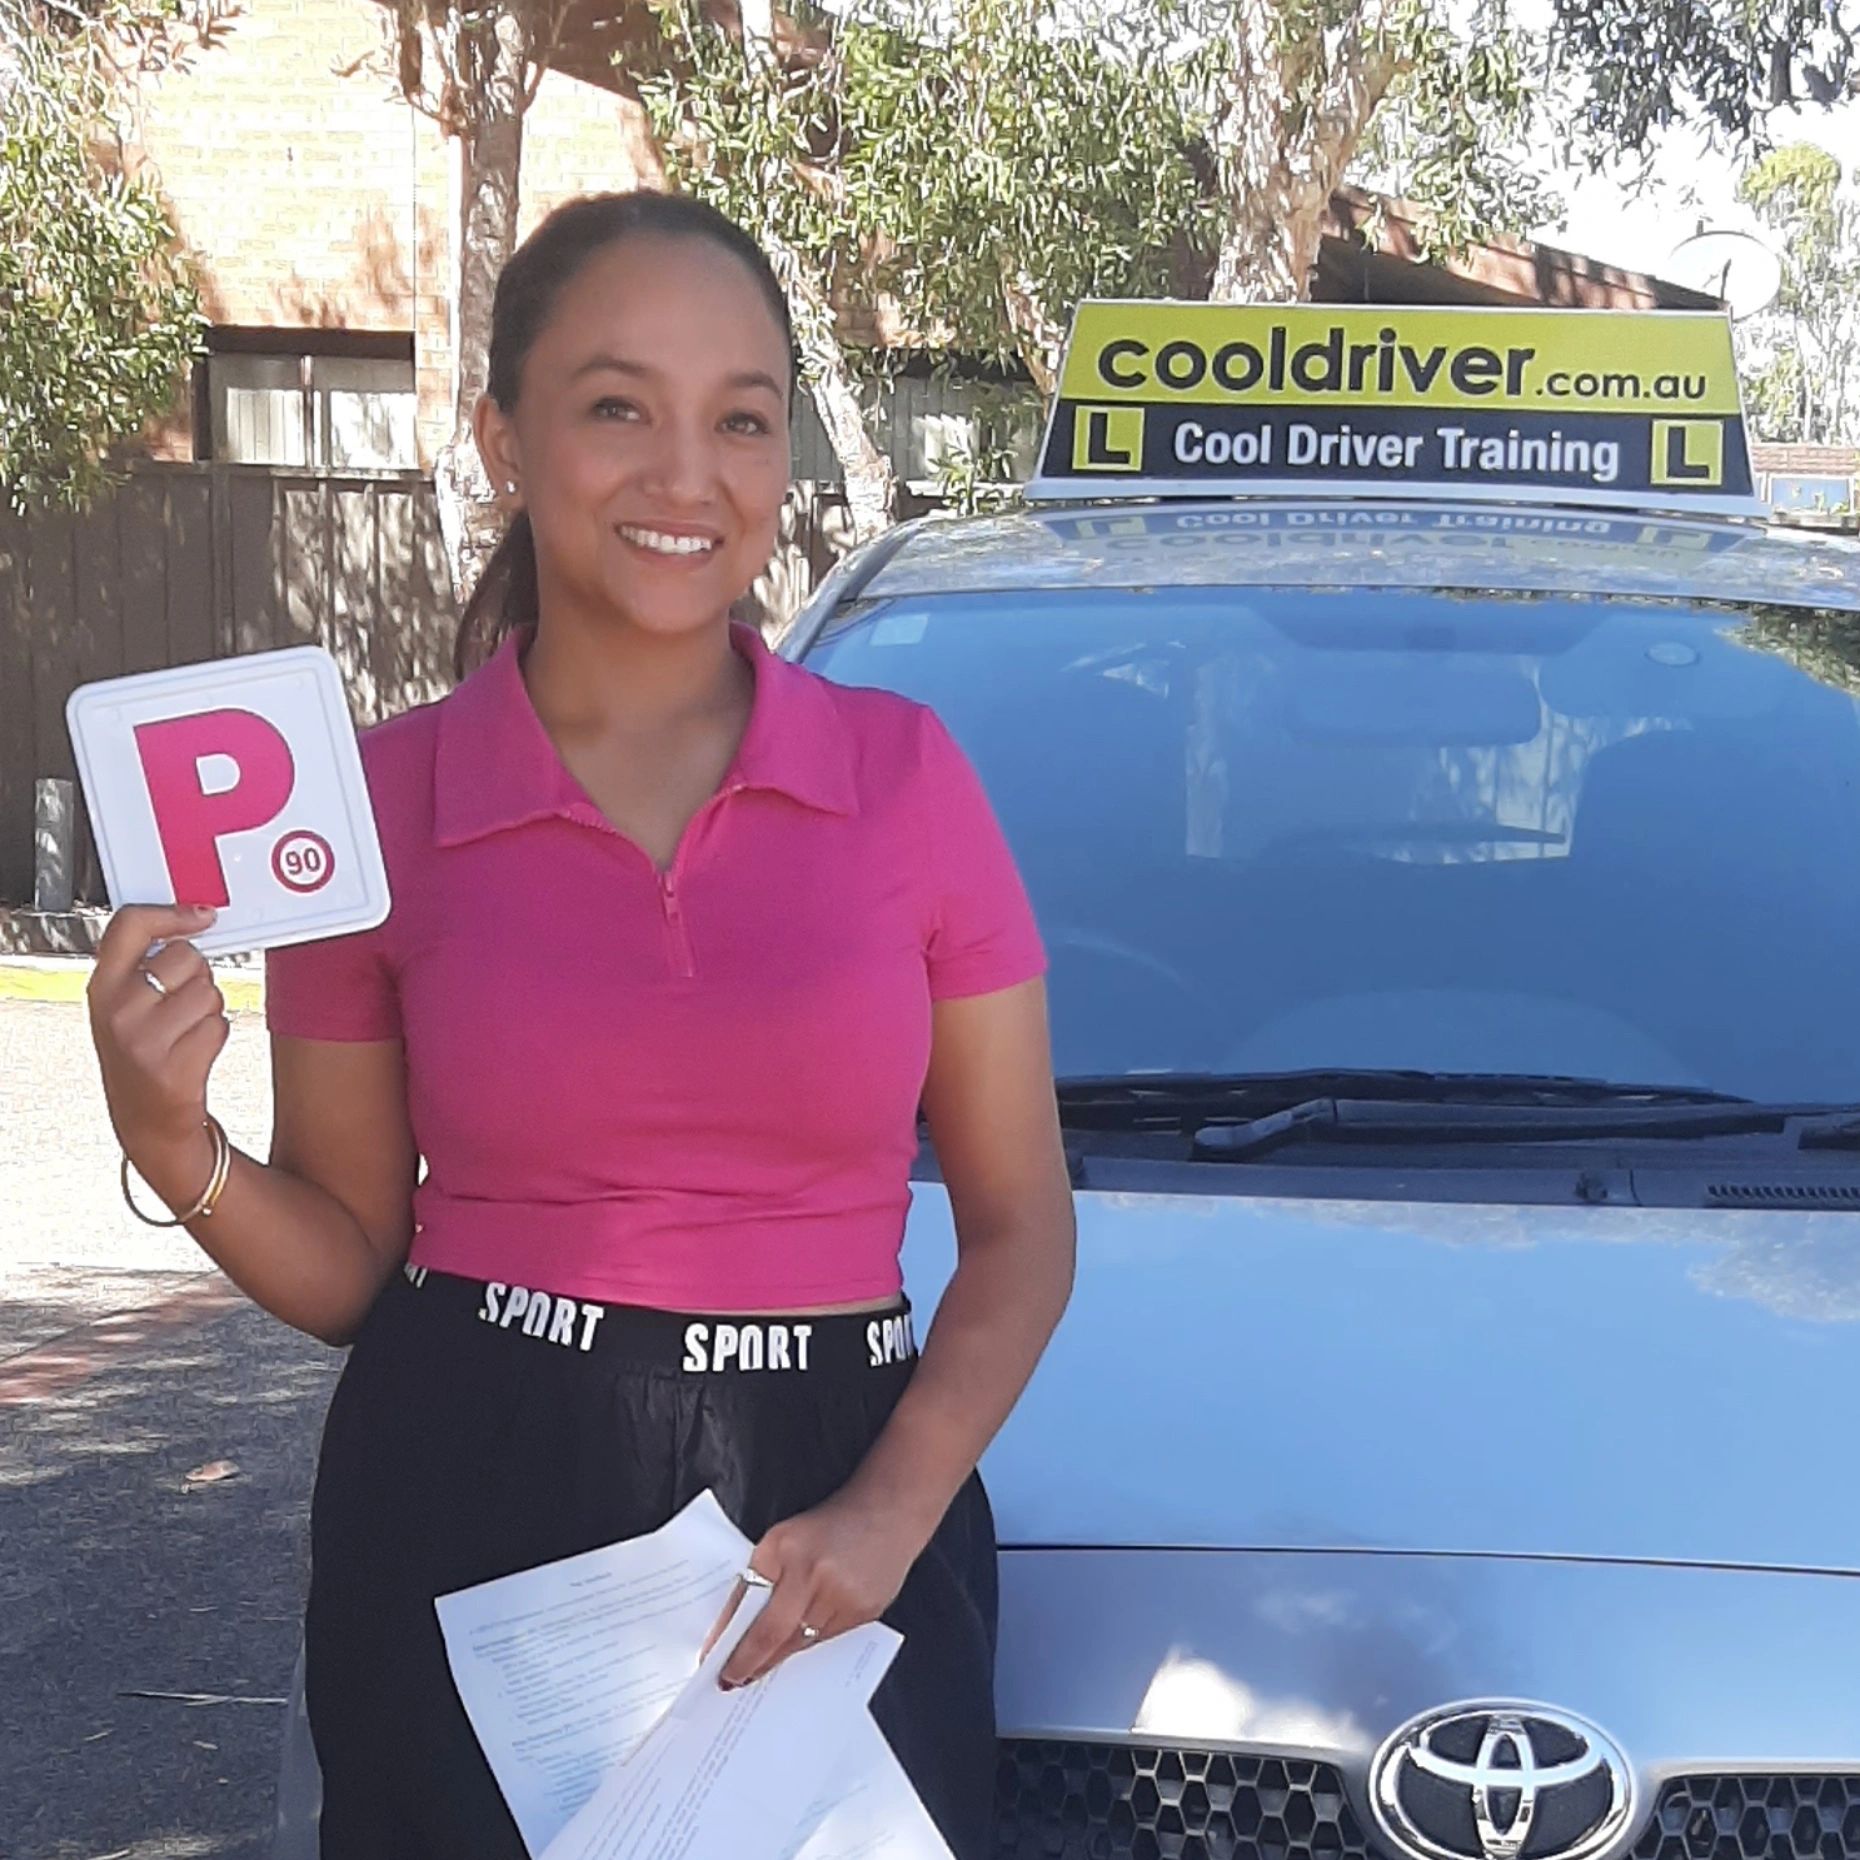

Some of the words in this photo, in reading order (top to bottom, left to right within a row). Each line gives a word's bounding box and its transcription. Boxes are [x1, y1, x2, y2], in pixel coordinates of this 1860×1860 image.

[1098, 326, 1706, 399] cooldriver.com.au
[1088, 411, 1130, 464] L
[1174, 421, 1271, 464] Cool
[1287, 424, 1424, 467] Driver
[1436, 427, 1619, 483] Training
[1667, 426, 1710, 479] L
[133, 708, 294, 907] P
[285, 847, 321, 876] 90
[479, 1282, 604, 1351] SPORT
[683, 1323, 812, 1372] SPORT
